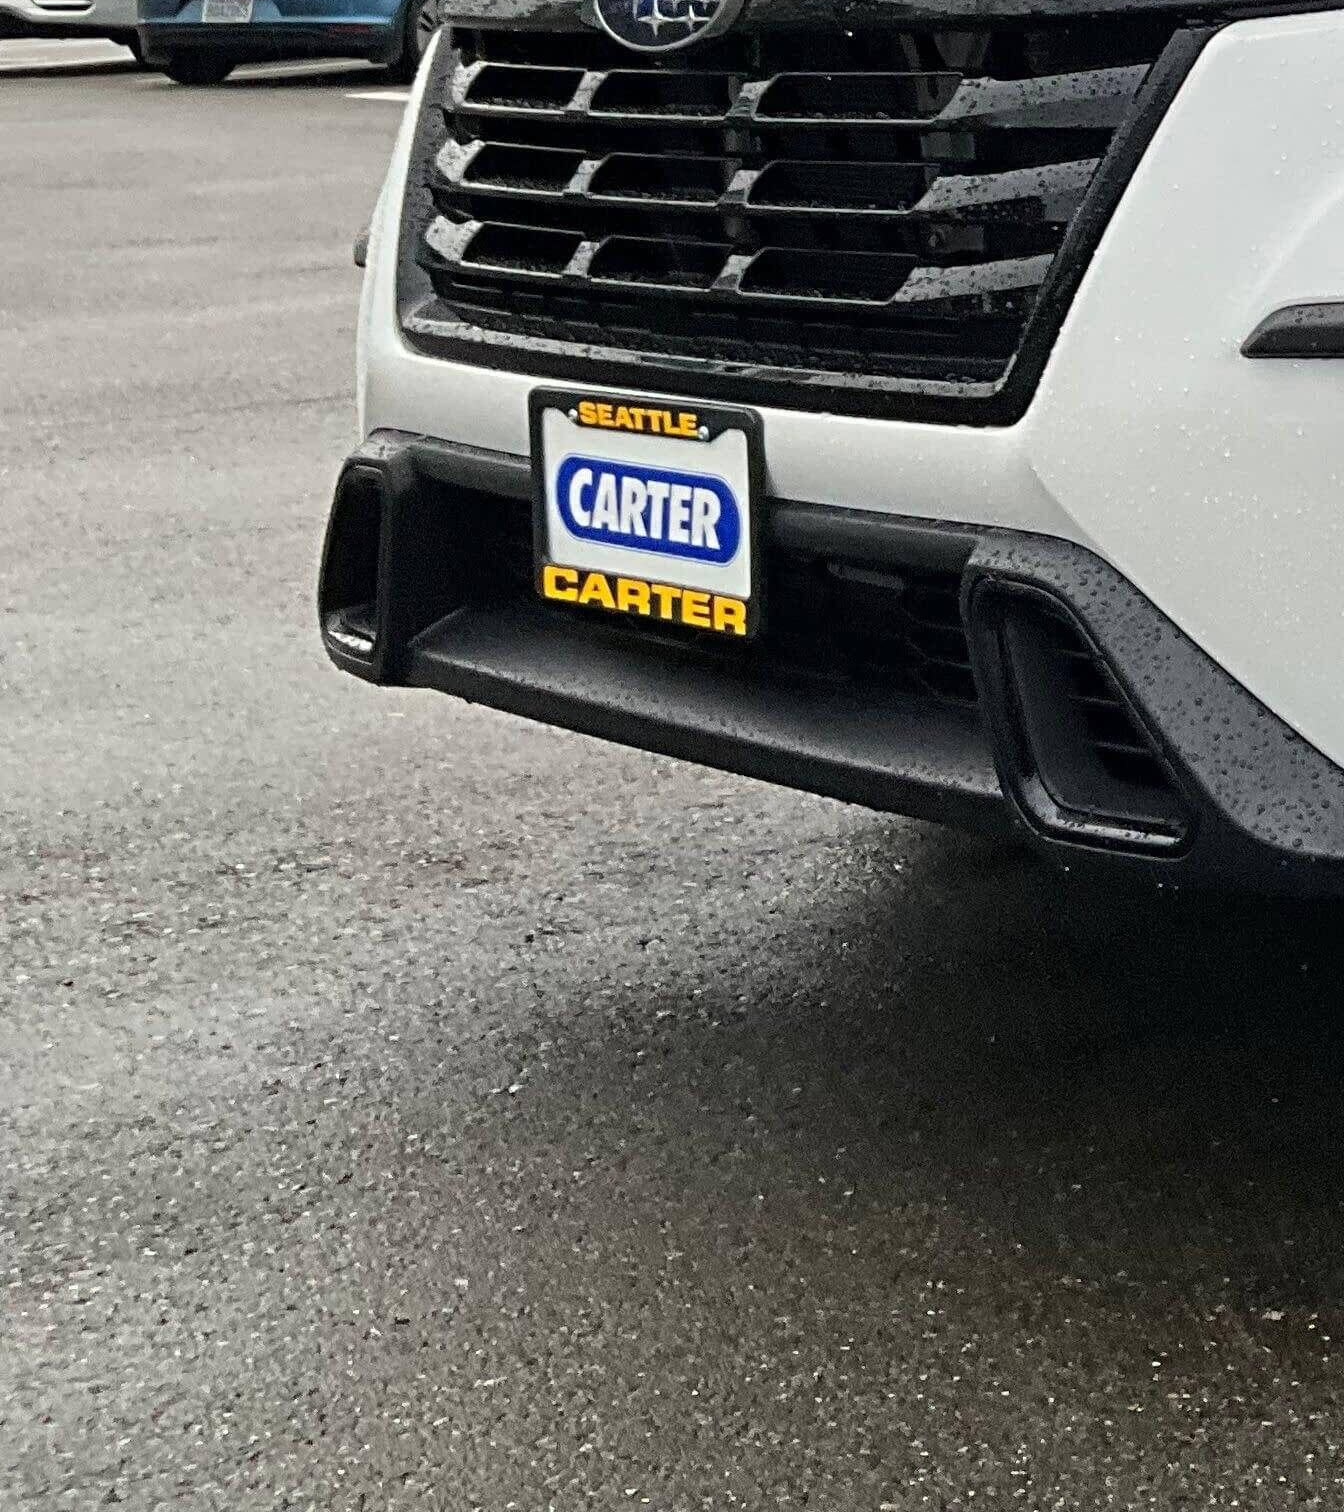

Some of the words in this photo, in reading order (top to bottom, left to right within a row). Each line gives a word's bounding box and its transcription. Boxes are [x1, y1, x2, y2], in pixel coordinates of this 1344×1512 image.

[577, 400, 698, 437] SEATTLE
[568, 467, 721, 550] CARTER
[543, 565, 747, 636] CARTER
